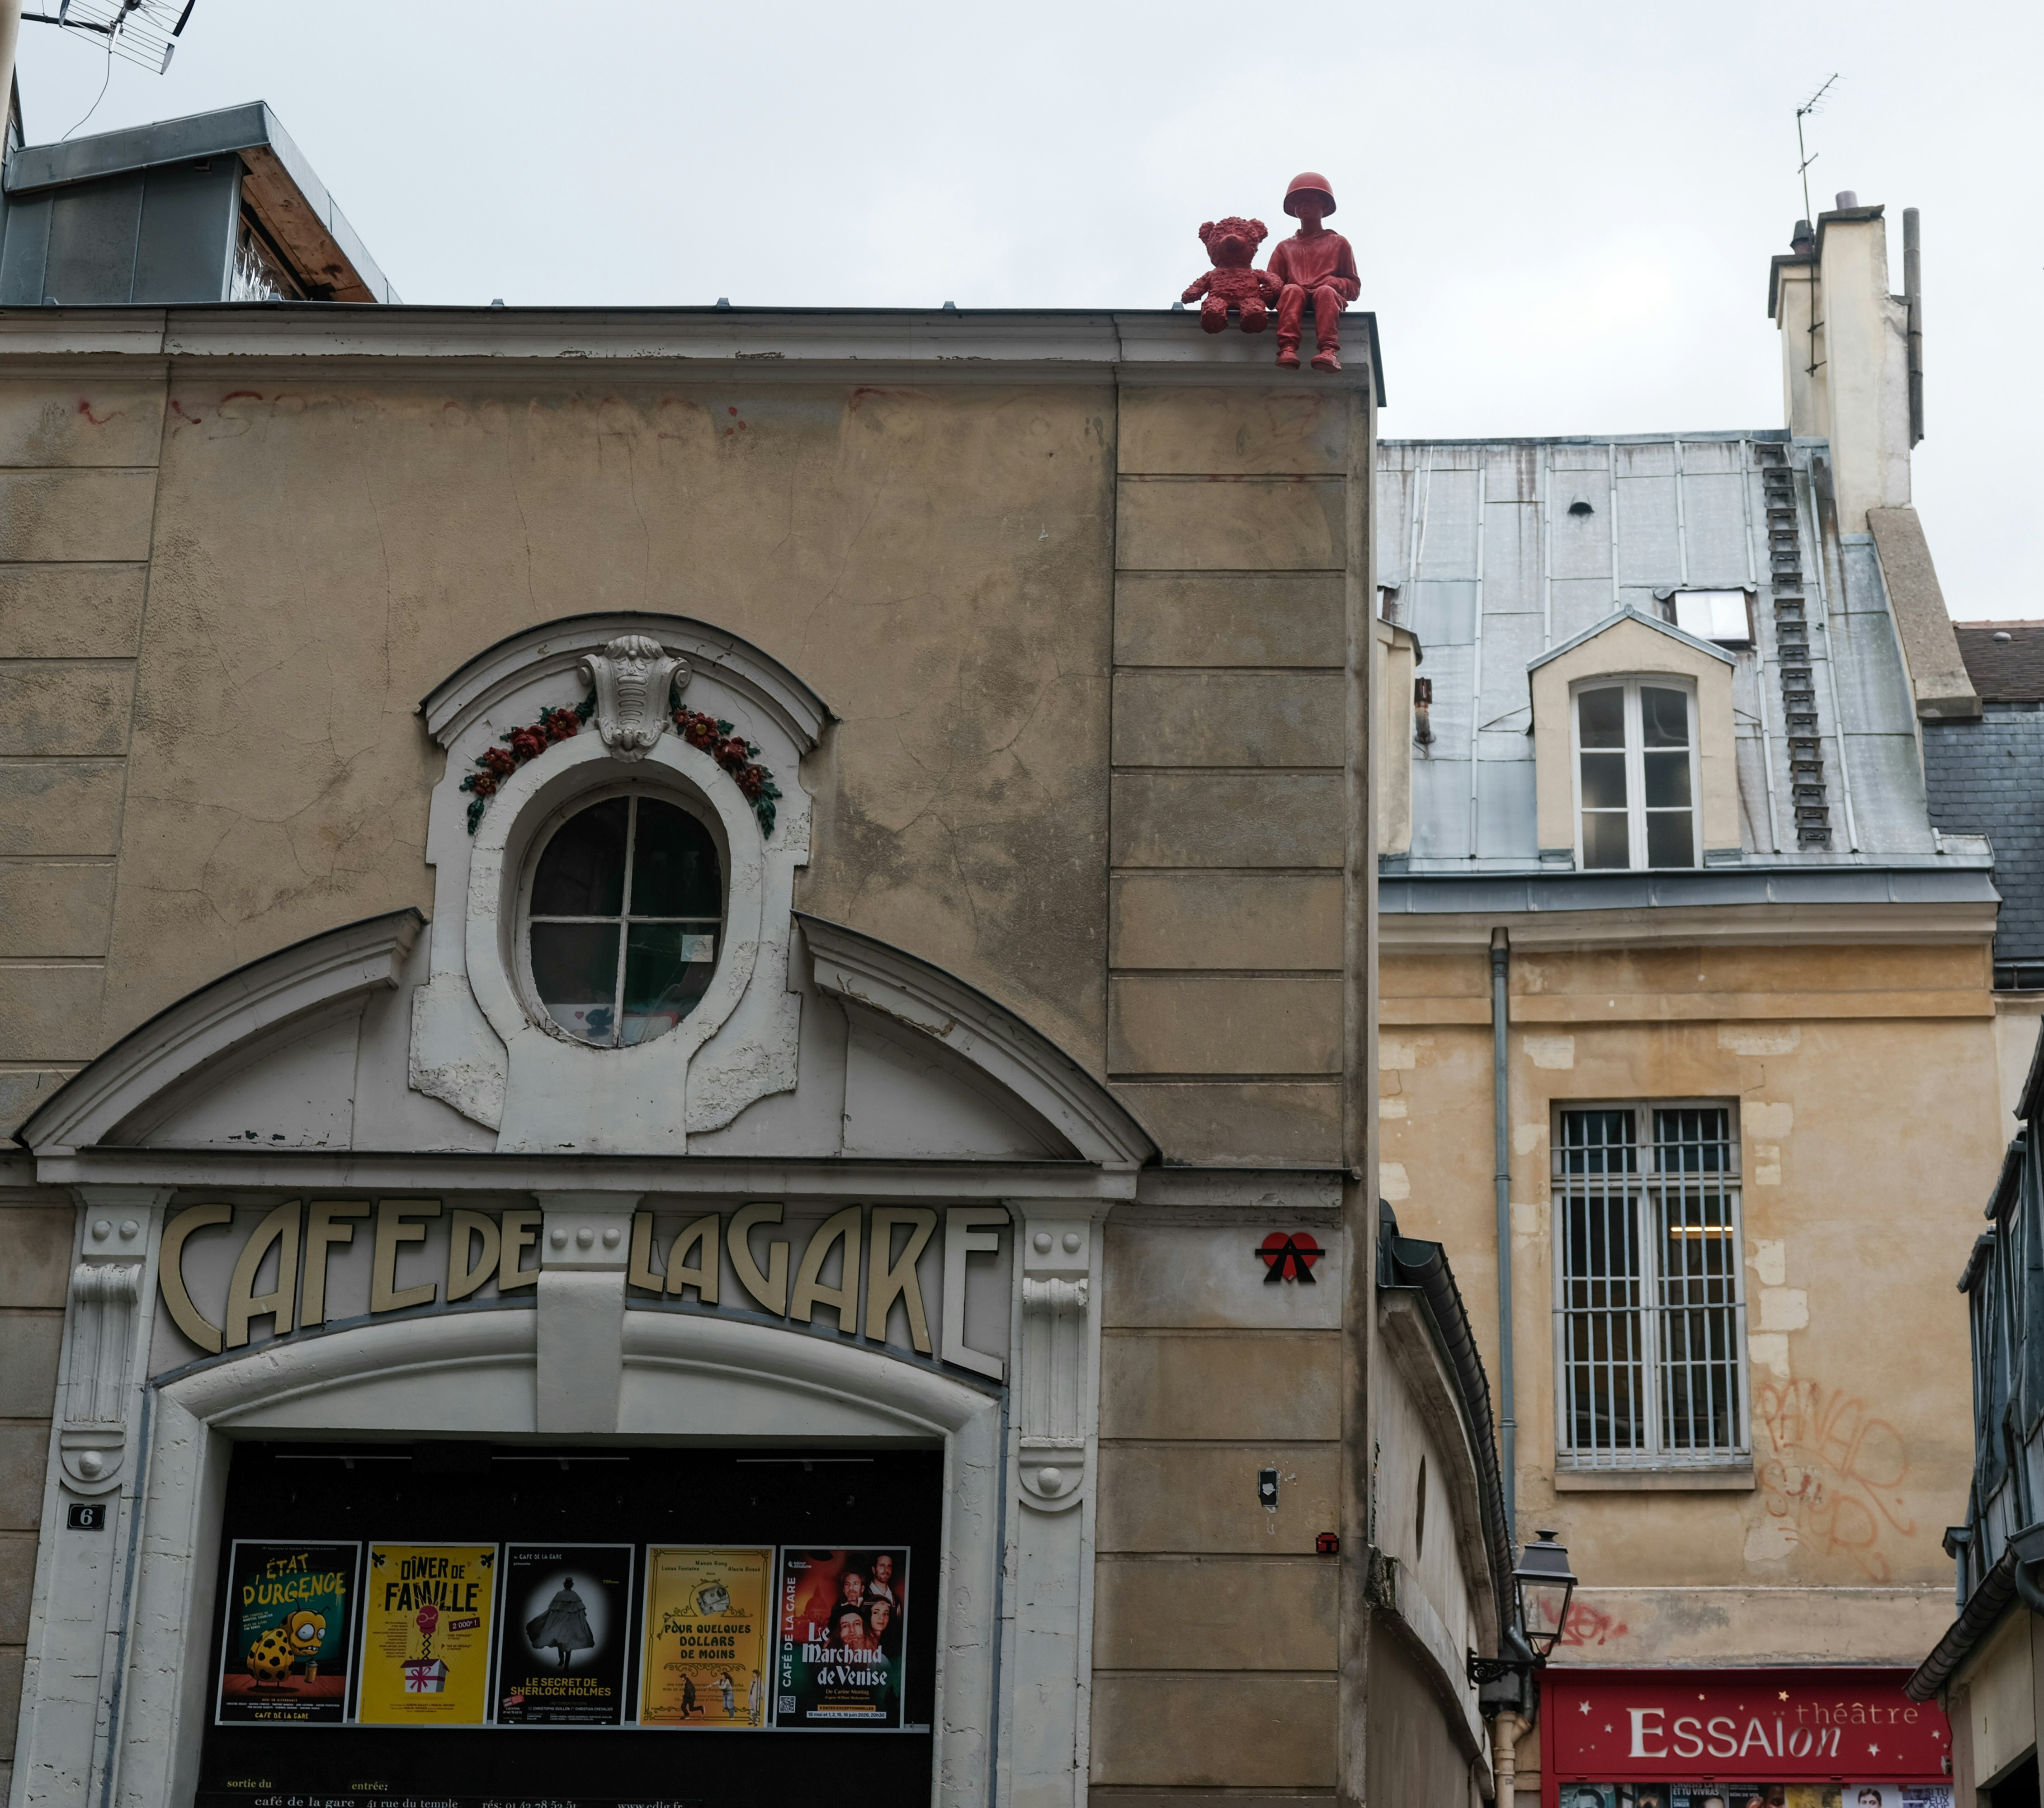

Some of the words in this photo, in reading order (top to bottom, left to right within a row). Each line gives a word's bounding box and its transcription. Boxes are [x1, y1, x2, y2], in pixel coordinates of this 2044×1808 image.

[160, 1200, 441, 1354] CAFE
[447, 1209, 542, 1302] DE
[629, 1210, 720, 1304] LA
[727, 1202, 1010, 1381] GARE
[80, 1508, 93, 1525] 6
[266, 1553, 309, 1580] ÉTAT
[401, 1555, 449, 1581] DÎNER
[451, 1565, 466, 1579] DE
[243, 1571, 346, 1606] D'URGENCE
[385, 1580, 479, 1612] FAMILLE
[786, 1577, 796, 1611] GARE
[665, 1624, 692, 1634] POUR
[697, 1624, 751, 1633] QUELQUES
[785, 1614, 794, 1630] LA
[808, 1622, 831, 1642] Le
[680, 1636, 735, 1647] DOLLARS
[784, 1634, 793, 1651] DE
[681, 1649, 694, 1658] DE
[699, 1649, 735, 1658] MOINS
[802, 1643, 882, 1665] Marchand
[782, 1654, 793, 1688] CAFÉ
[817, 1667, 836, 1686] de
[836, 1666, 888, 1686] Venise
[526, 1677, 539, 1686] LE
[541, 1678, 581, 1686] SECRET
[584, 1678, 598, 1686] DE
[510, 1686, 566, 1696] SHERLOCK
[568, 1687, 612, 1696] HOLMES
[1795, 1702, 1918, 1724] théâtre
[227, 1779, 256, 1788] sortie
[259, 1779, 272, 1788] du
[351, 1781, 388, 1791] entrée:
[1925, 1788, 1934, 1796] SI
[1935, 1788, 1949, 1796] TU
[255, 1796, 283, 1806] café
[287, 1796, 304, 1806] de
[308, 1797, 321, 1807] la
[325, 1799, 354, 1808] gare
[402, 1798, 417, 1808] du
[420, 1798, 458, 1808] temple
[1923, 1796, 1949, 1804] VEUX
